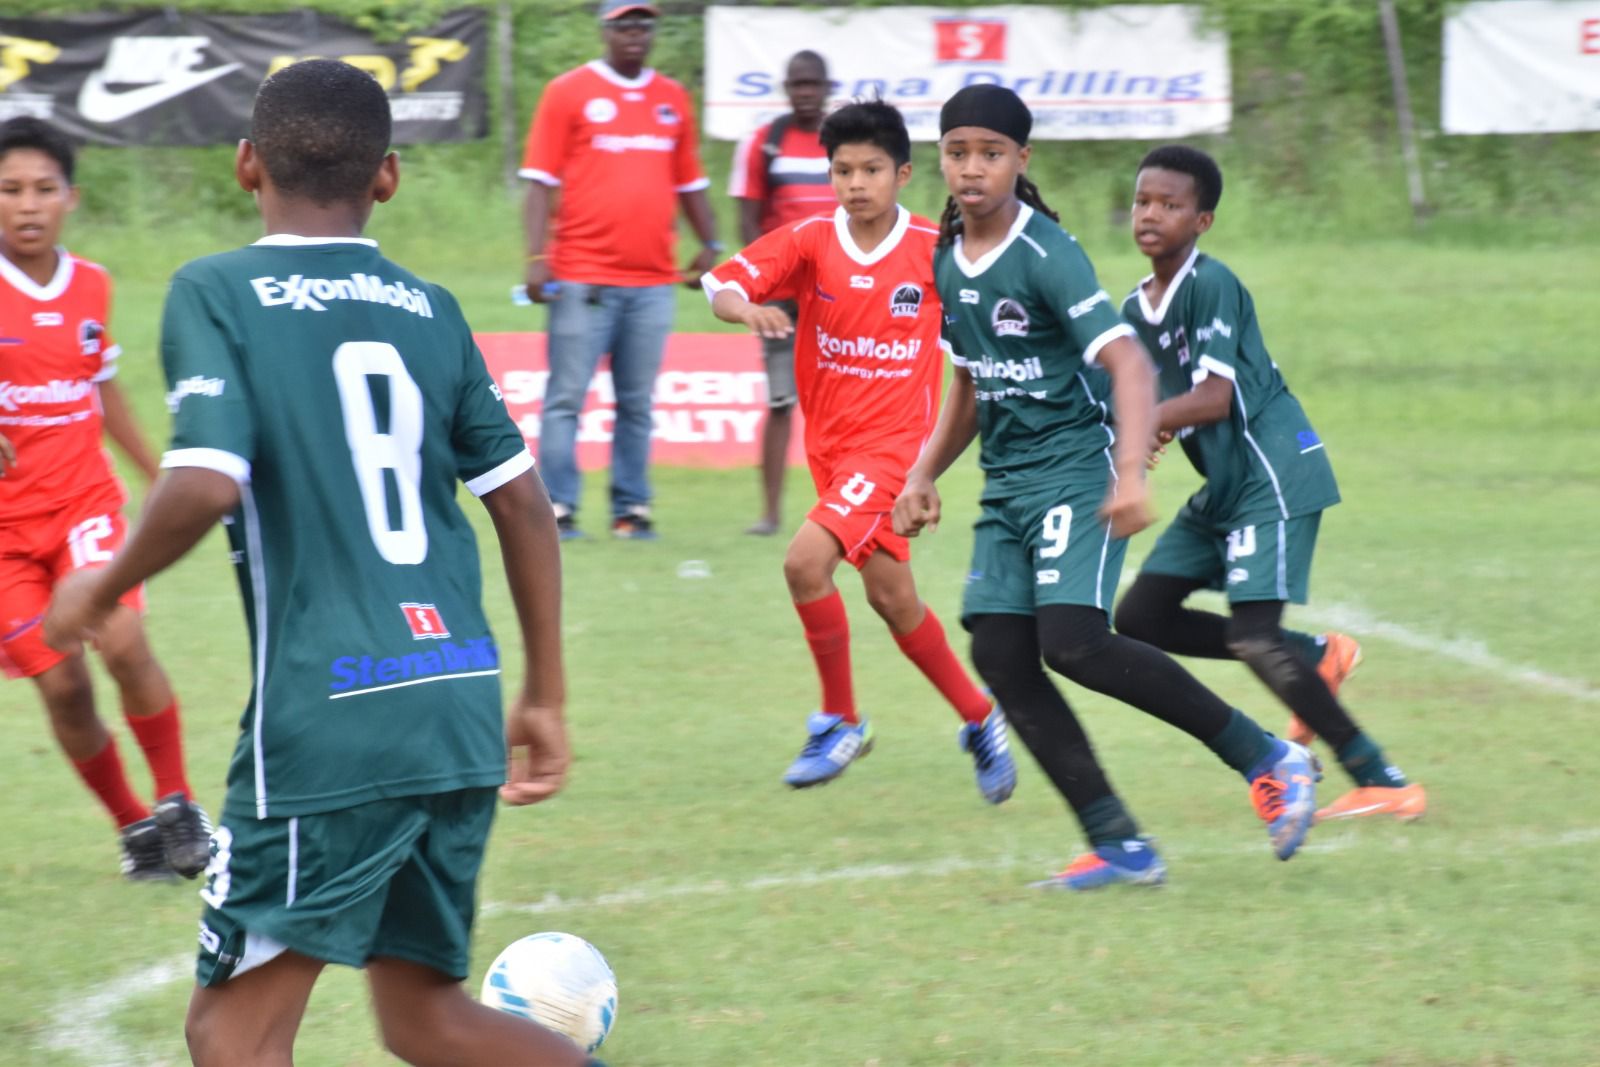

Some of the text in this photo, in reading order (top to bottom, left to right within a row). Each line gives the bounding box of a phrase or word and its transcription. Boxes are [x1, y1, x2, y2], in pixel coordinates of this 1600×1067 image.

[956, 24, 984, 56] S
[250, 273, 433, 319] ExxonMobil
[332, 341, 428, 565] 8
[66, 513, 114, 569] 12
[1040, 504, 1073, 558] 9
[415, 610, 434, 632] S
